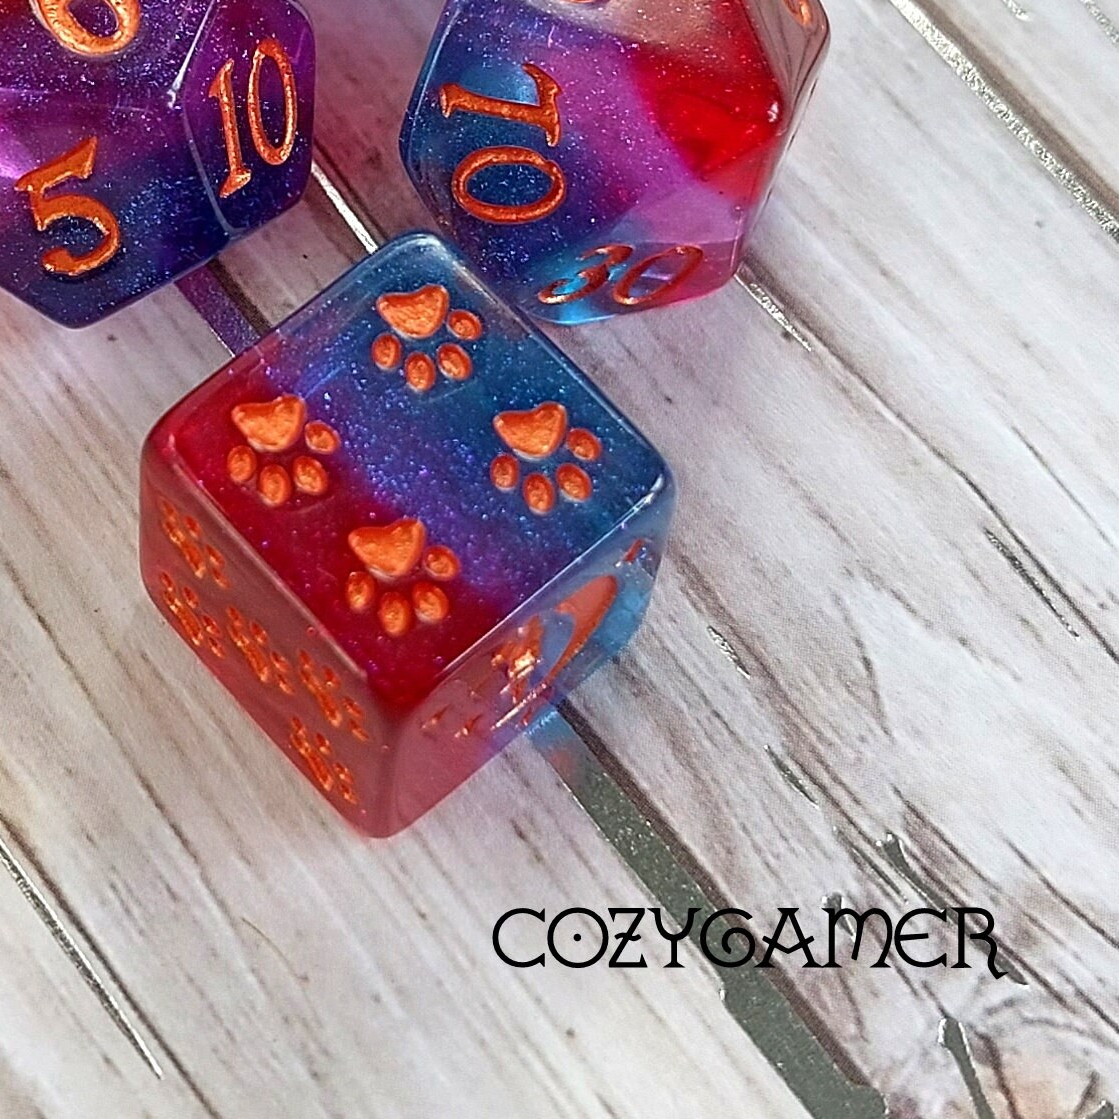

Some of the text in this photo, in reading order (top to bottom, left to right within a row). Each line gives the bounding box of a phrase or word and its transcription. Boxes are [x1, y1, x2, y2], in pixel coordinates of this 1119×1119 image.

[208, 38, 297, 198] 10
[440, 62, 568, 224] 70
[14, 135, 121, 276] 5
[538, 244, 704, 305] 30
